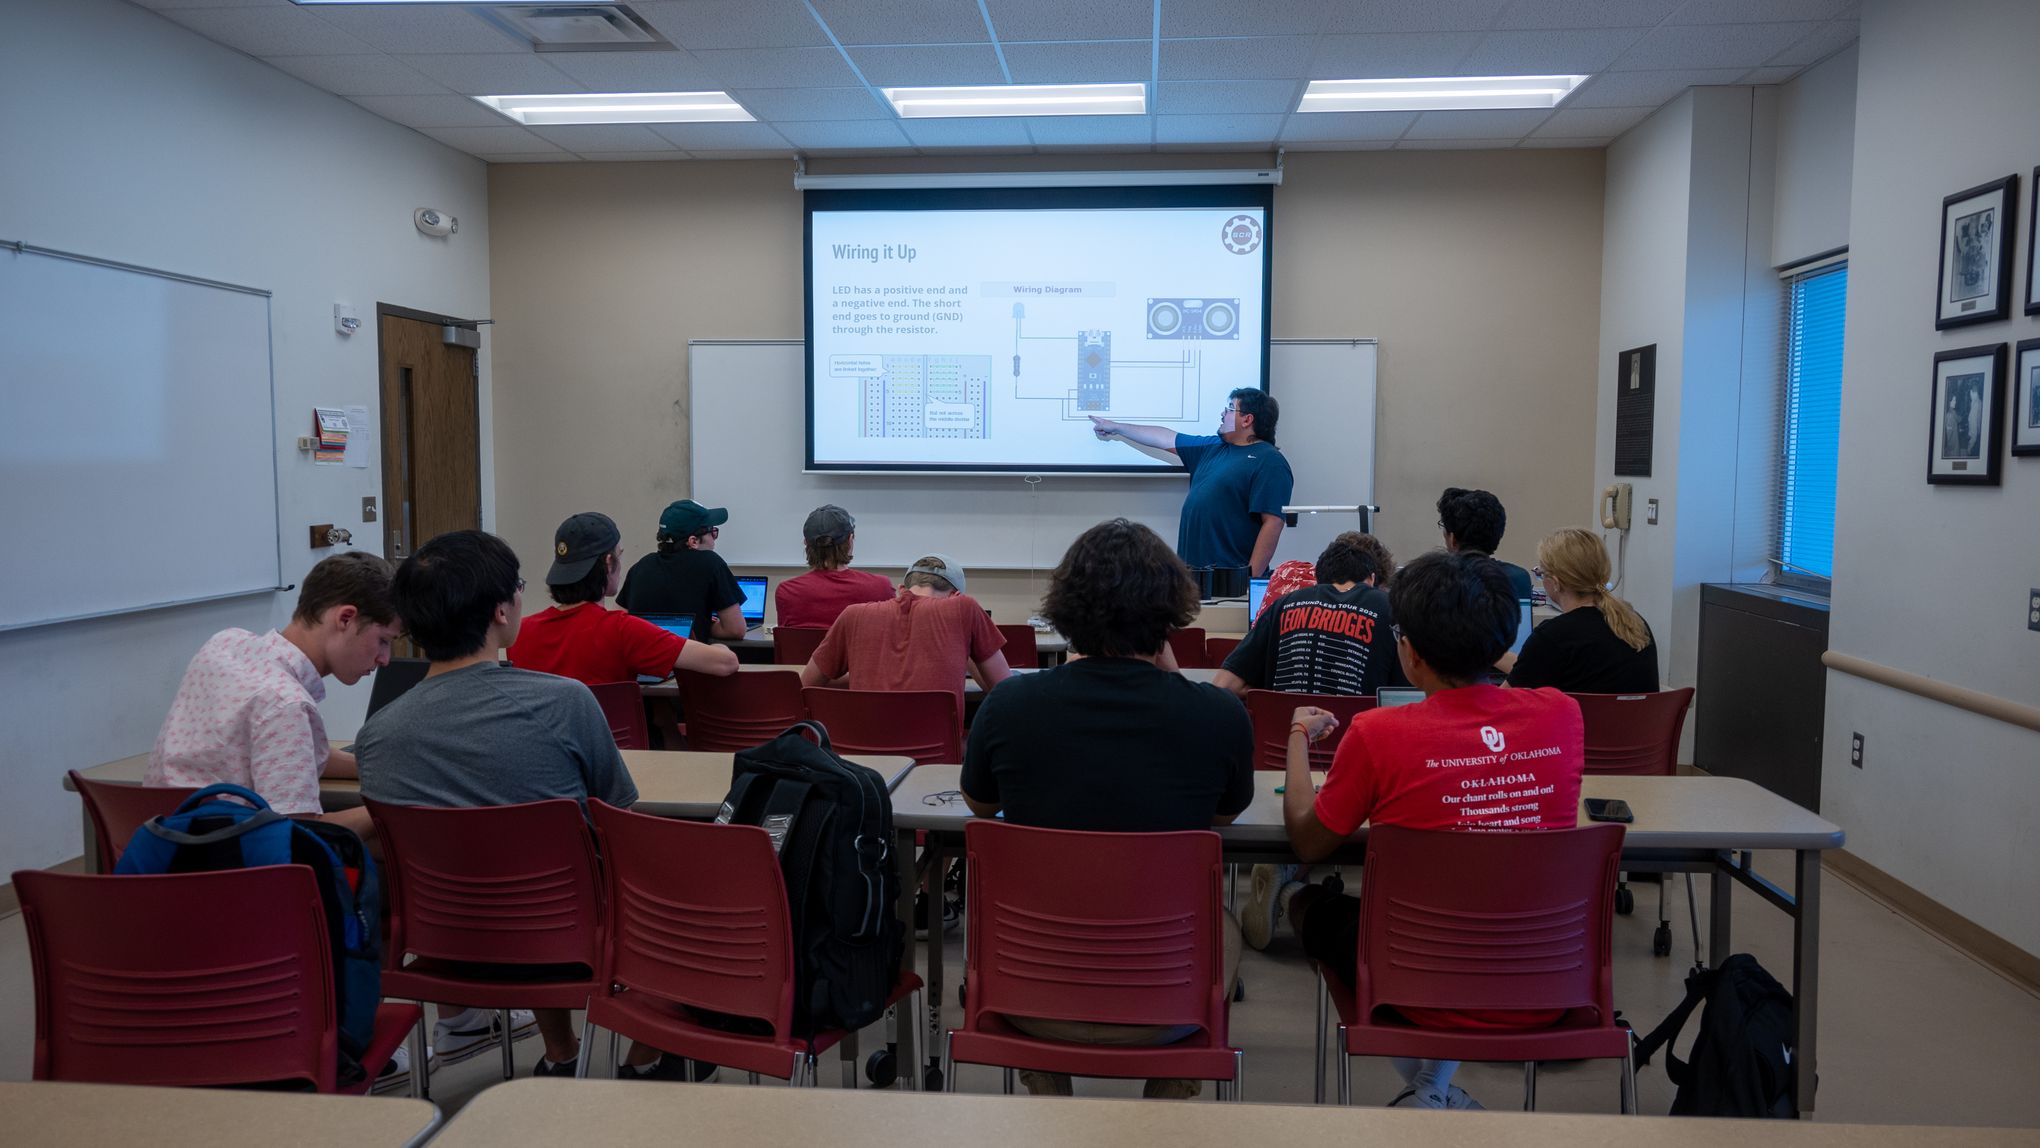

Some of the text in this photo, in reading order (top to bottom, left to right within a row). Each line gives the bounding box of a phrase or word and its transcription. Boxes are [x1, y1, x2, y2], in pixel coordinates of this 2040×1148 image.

[832, 244, 917, 263] Wiring it Up
[832, 286, 850, 294] LED
[854, 286, 872, 294] has
[883, 286, 924, 296] positive
[926, 286, 945, 294] end
[949, 285, 968, 294] and
[1013, 286, 1082, 294] Wiring Diagram
[841, 299, 885, 309] negative
[888, 299, 909, 308] end.
[912, 299, 931, 308] The
[934, 299, 962, 308] short
[832, 312, 851, 321] end
[854, 313, 877, 322] goes
[893, 312, 930, 322] ground
[932, 312, 963, 322] (GND)
[832, 325, 938, 336] through the resistor.
[1296, 600, 1336, 609] BOUNDLESS
[1359, 608, 1378, 618] 2022
[1280, 607, 1375, 644] LEON BRIDGES
[1480, 726, 1506, 752] OU
[1441, 755, 1497, 767] UNIVERSITY
[1499, 754, 1508, 764] of
[1511, 747, 1561, 760] OKLAHOMA
[1442, 795, 1461, 803] Our
[1462, 794, 1486, 802] chant
[1488, 791, 1508, 800] rolls
[1523, 786, 1539, 796] and
[1540, 784, 1554, 794] on!
[1460, 802, 1539, 816] Thousands strong
[1503, 816, 1519, 826] and
